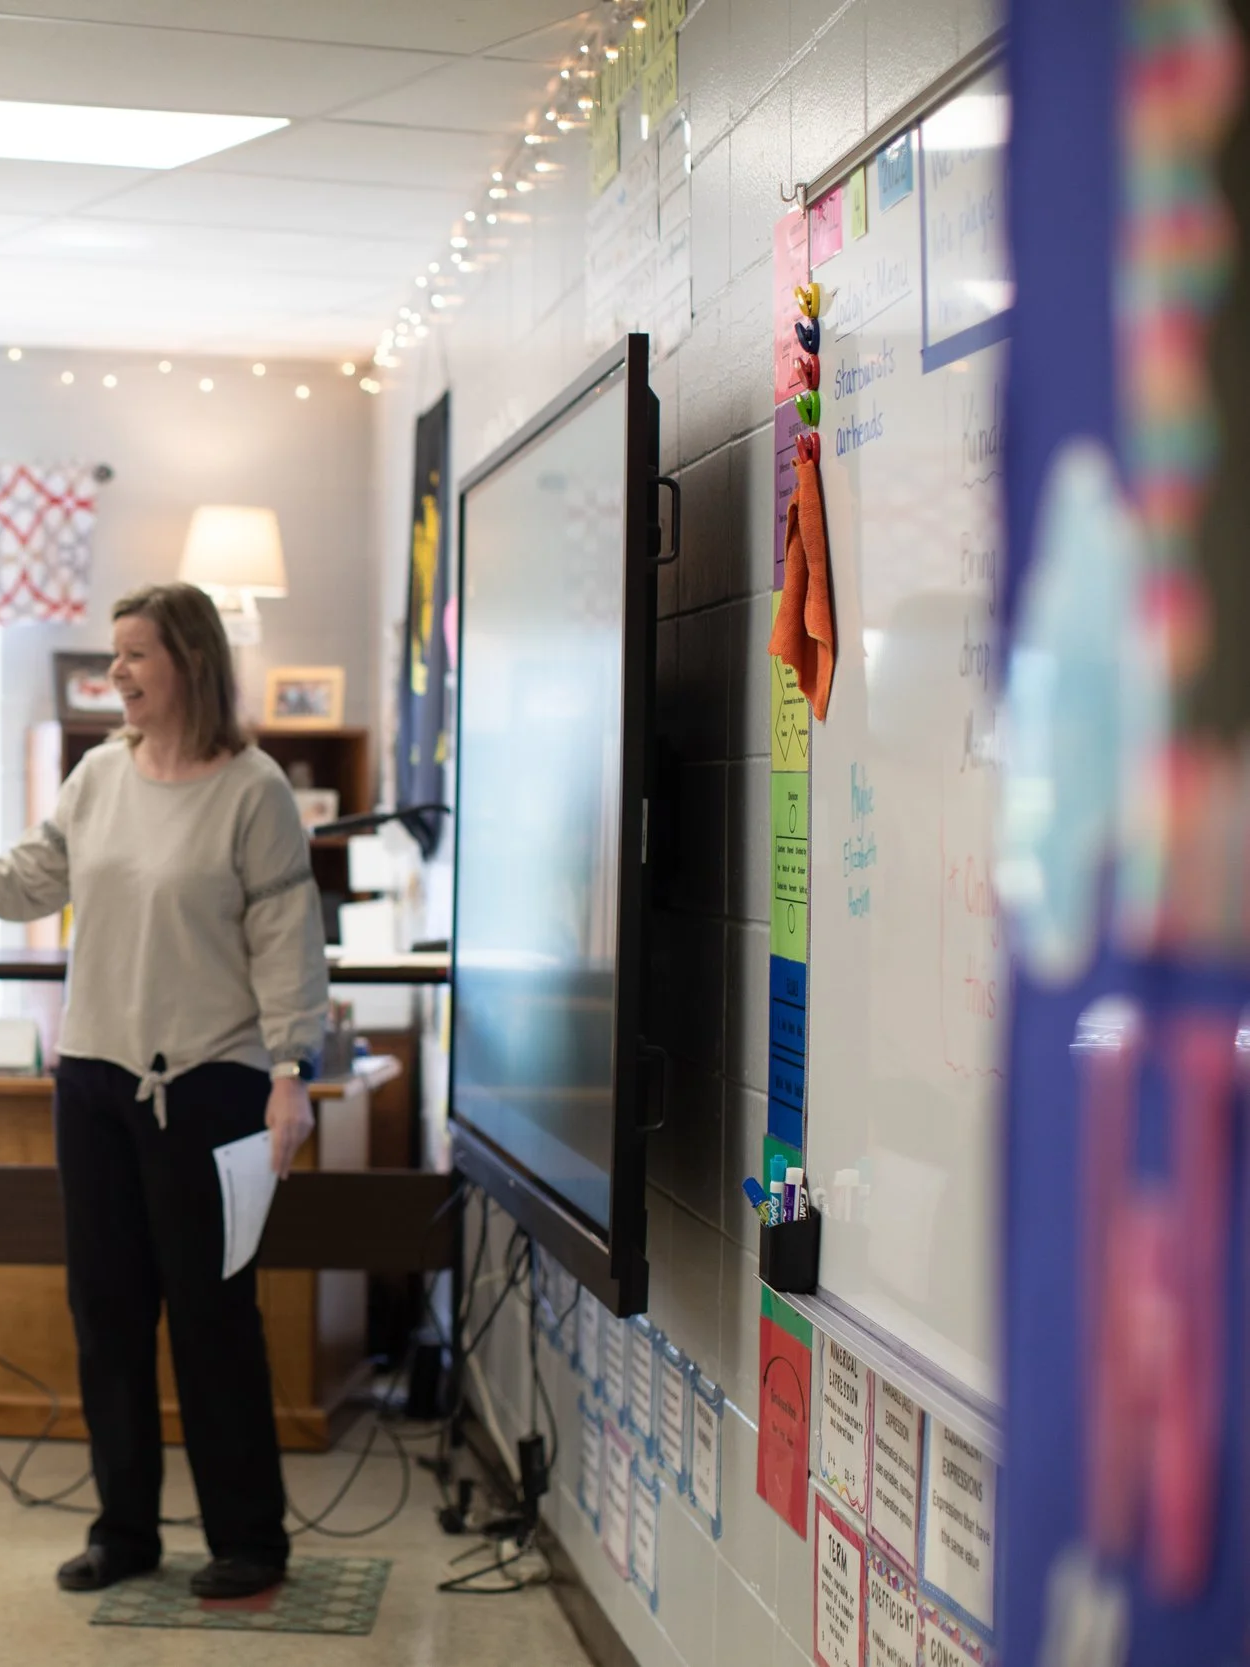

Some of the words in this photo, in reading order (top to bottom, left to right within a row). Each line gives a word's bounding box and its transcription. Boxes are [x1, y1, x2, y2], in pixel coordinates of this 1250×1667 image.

[788, 791, 798, 801] Division
[830, 1340, 859, 1378] NUMERICAL
[829, 1368, 859, 1408] EXPRESSION
[885, 1409, 909, 1442] EXPRESSION
[942, 1456, 983, 1503] EXPRESSIONS
[932, 1488, 963, 1527] Expressions
[963, 1509, 974, 1537] that
[975, 1518, 991, 1547] have
[828, 1533, 847, 1577] TERM
[941, 1526, 950, 1548] the
[950, 1536, 964, 1561] same
[965, 1549, 980, 1572] value
[871, 1579, 914, 1637] COEFFICIENT
